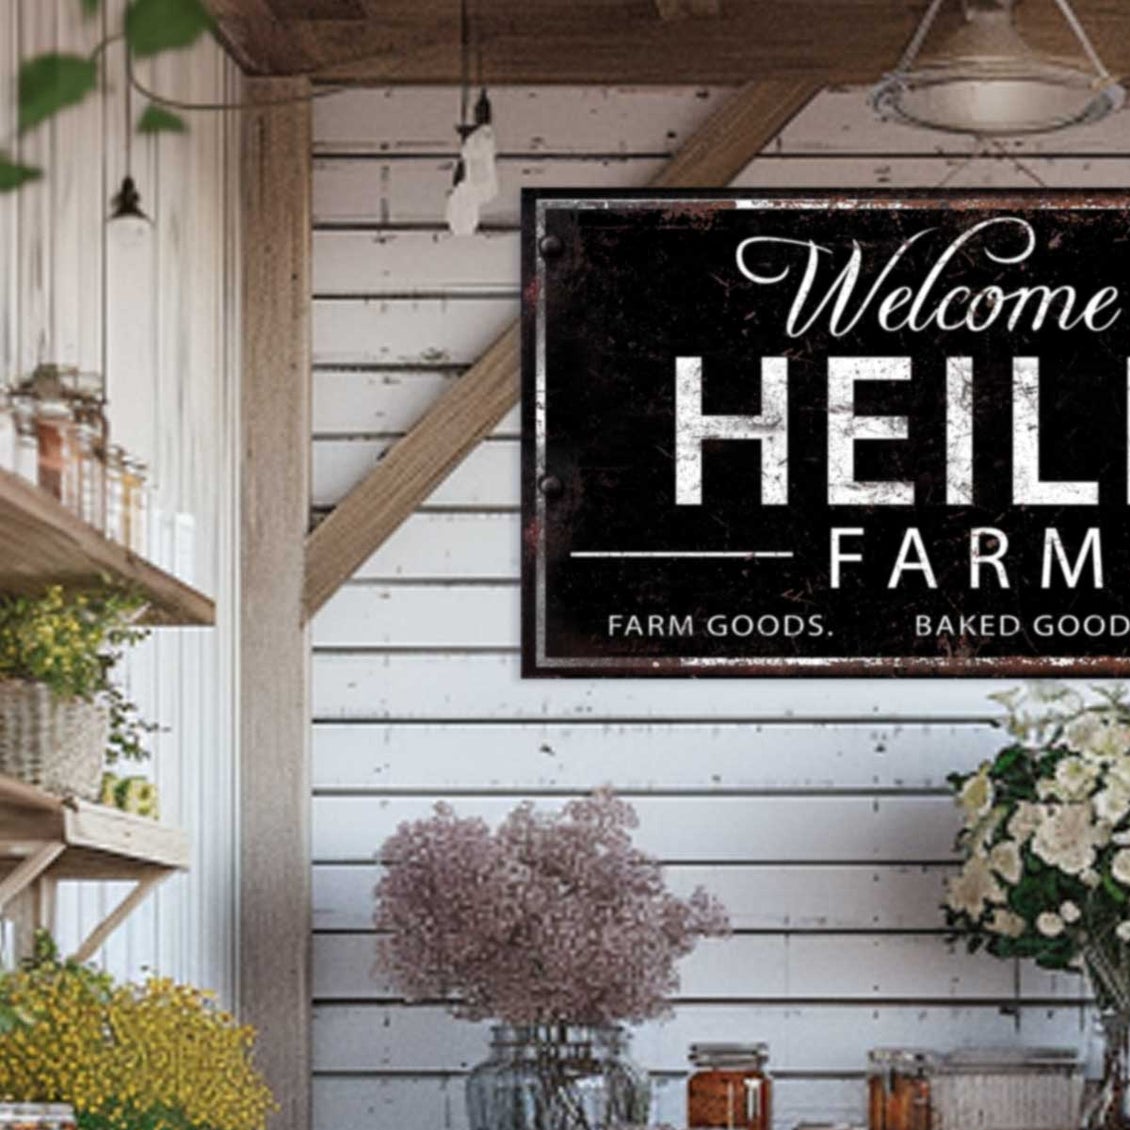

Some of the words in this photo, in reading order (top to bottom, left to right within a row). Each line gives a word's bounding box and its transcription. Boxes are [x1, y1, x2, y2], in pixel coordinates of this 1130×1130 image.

[735, 216, 1122, 338] Welcome
[608, 614, 693, 637] FARM
[707, 614, 835, 637] GOODS.
[915, 614, 1020, 637] BAKED
